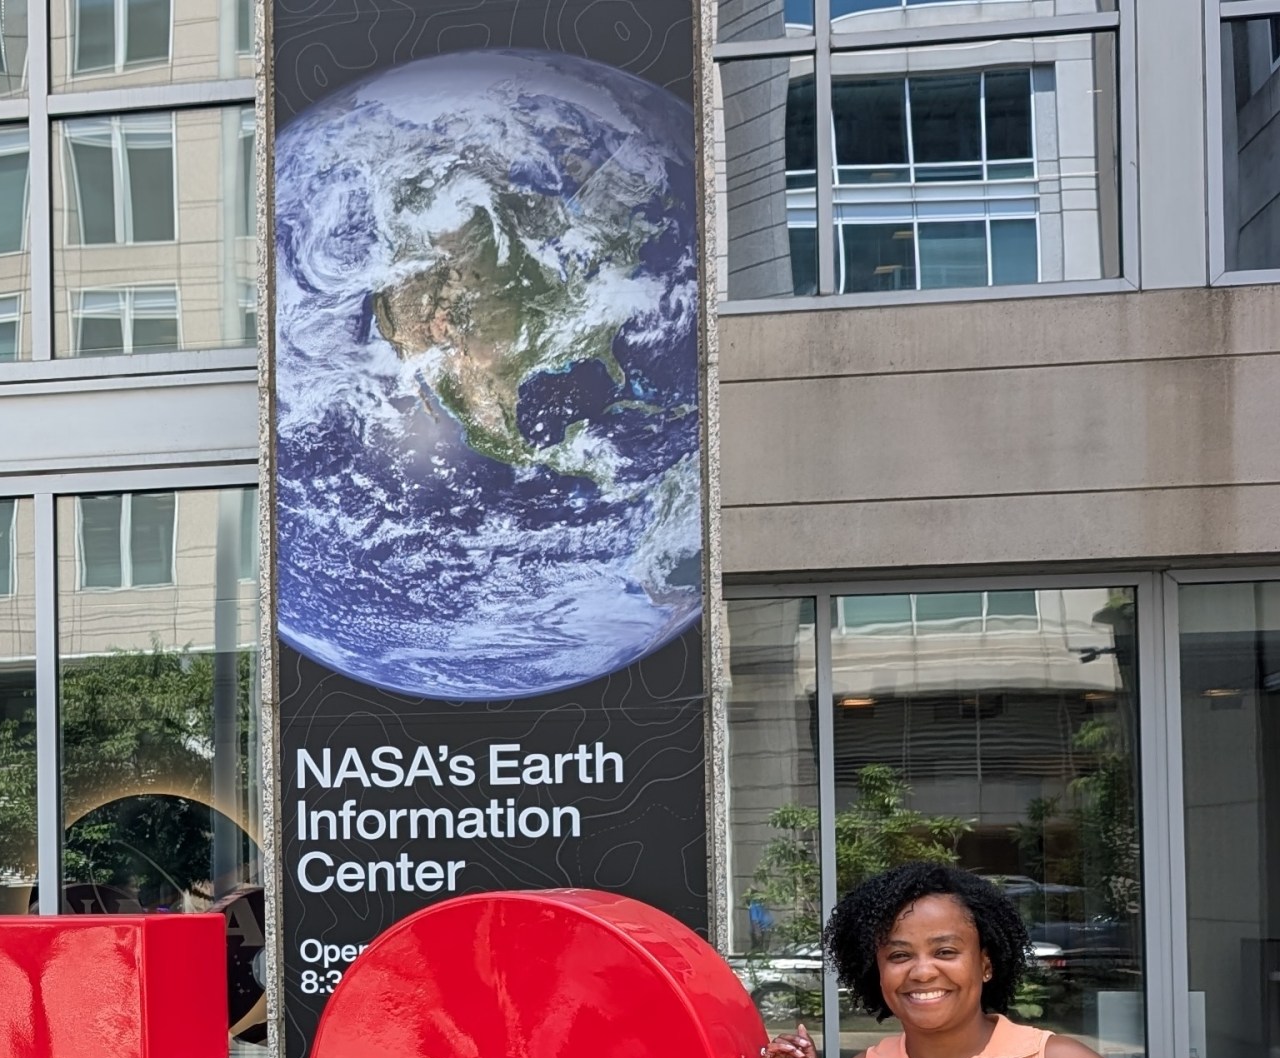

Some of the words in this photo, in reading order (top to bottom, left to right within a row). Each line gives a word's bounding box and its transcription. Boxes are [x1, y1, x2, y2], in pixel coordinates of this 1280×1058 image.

[296, 744, 476, 789] NASA's
[489, 741, 624, 786] Earth
[297, 798, 581, 841] Information
[297, 850, 466, 893] Center
